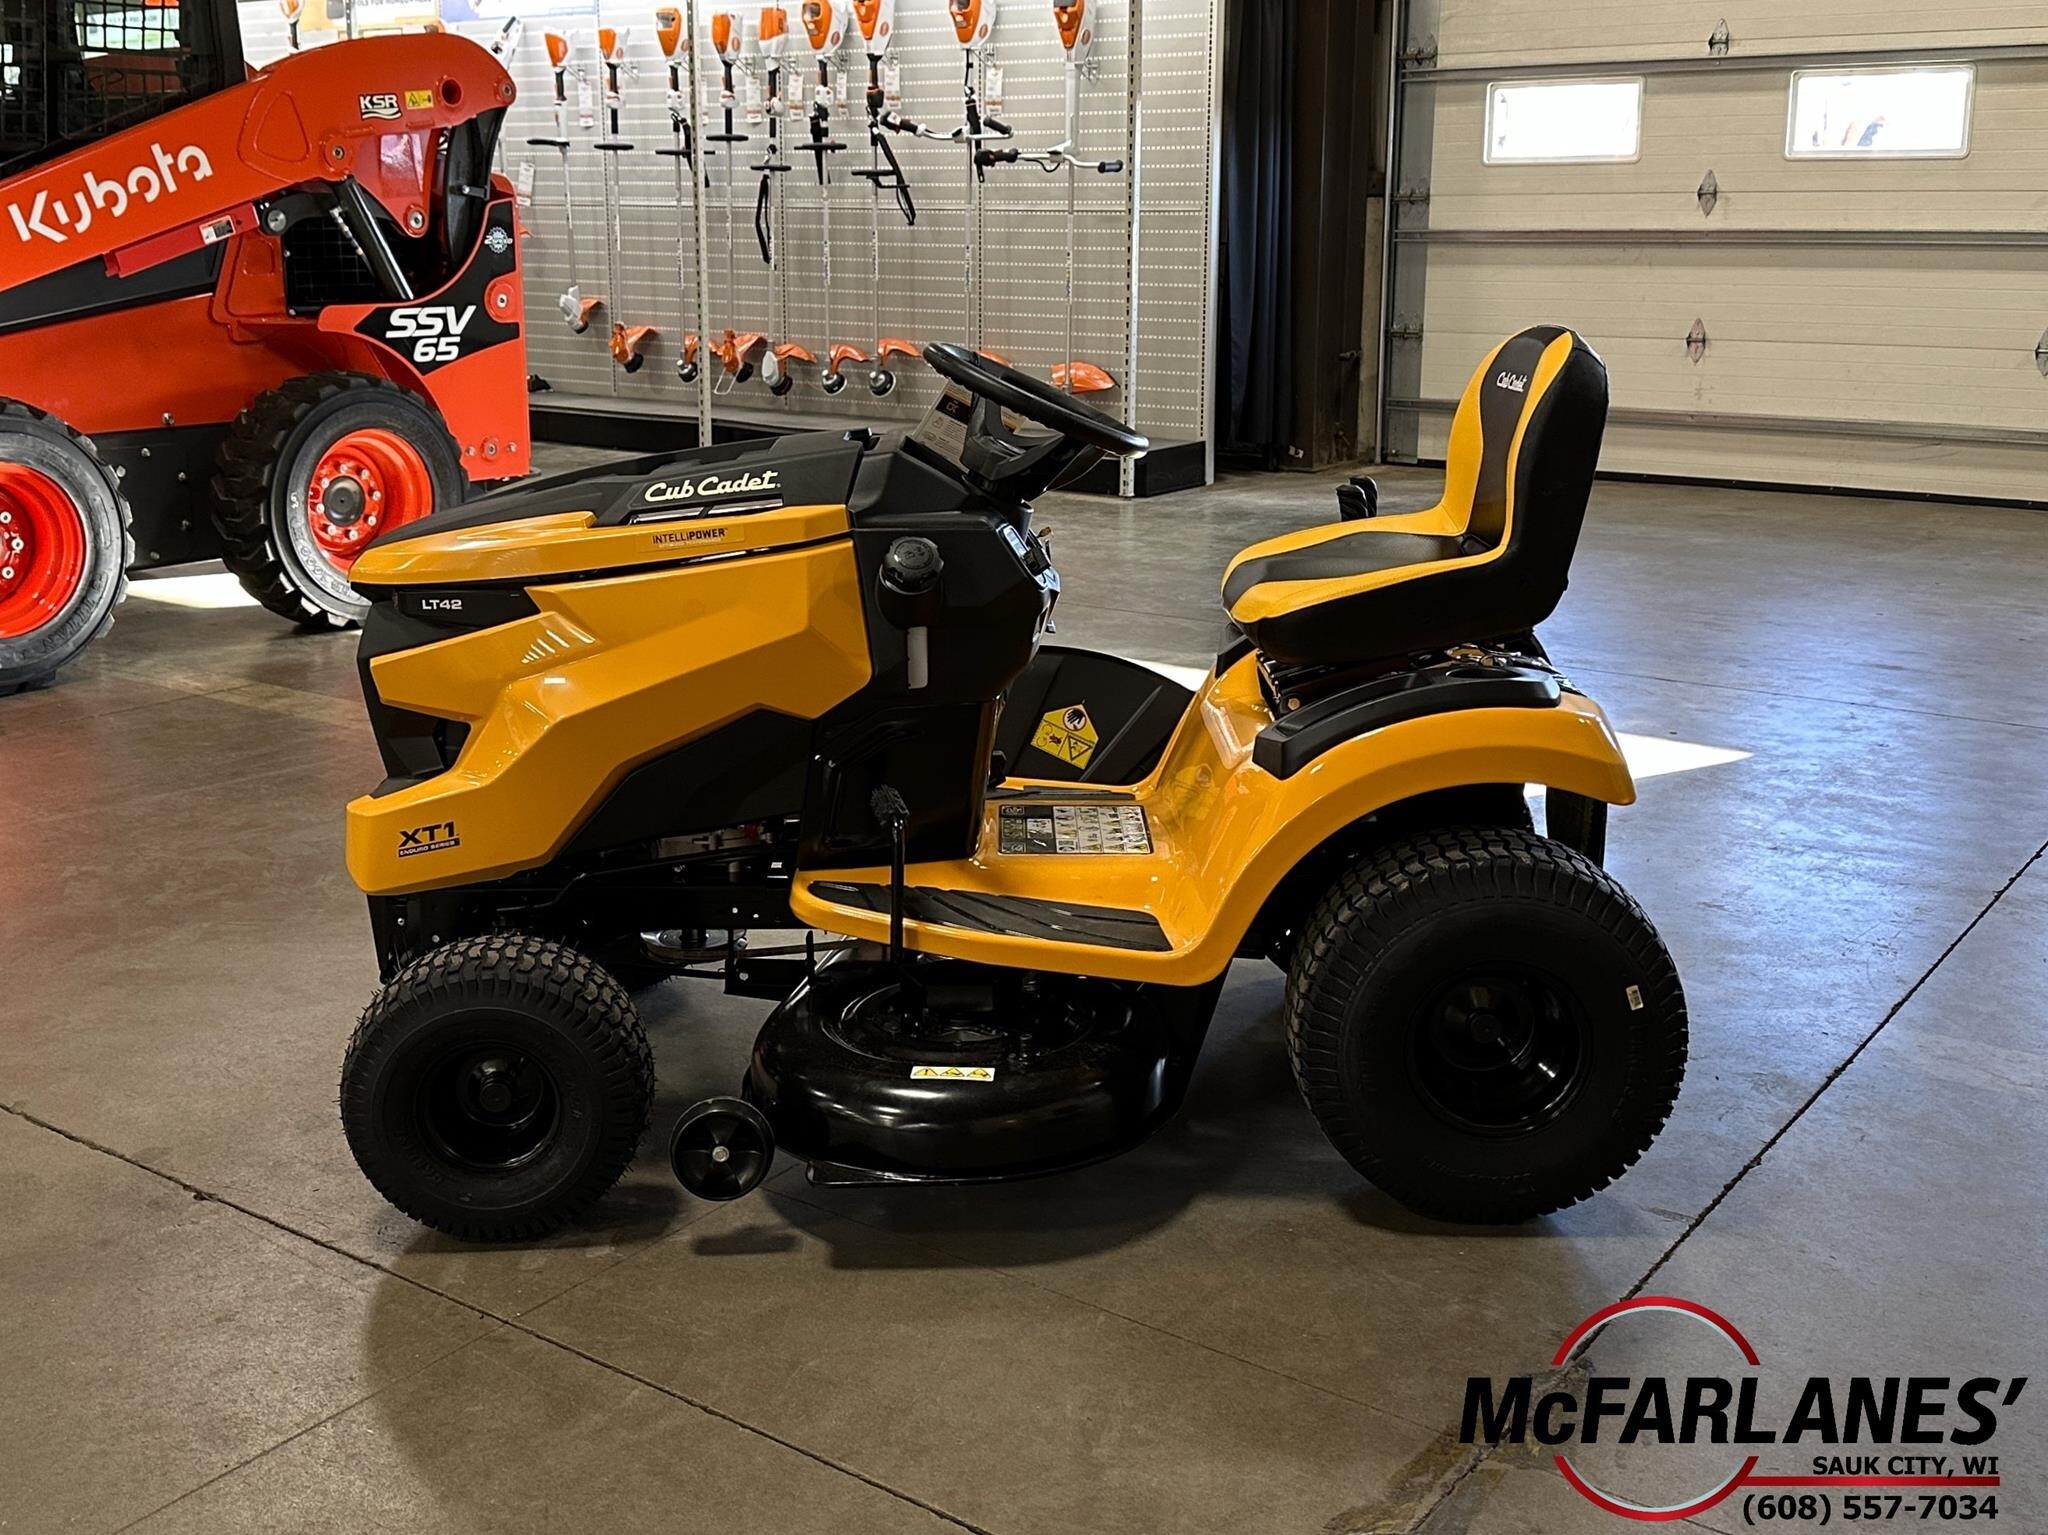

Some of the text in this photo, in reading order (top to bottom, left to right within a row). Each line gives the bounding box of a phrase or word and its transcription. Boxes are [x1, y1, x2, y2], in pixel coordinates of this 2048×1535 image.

[360, 95, 398, 109] KSR
[7, 142, 213, 243] Kubota
[385, 305, 477, 338] SSV
[413, 336, 461, 362] 65
[644, 470, 779, 502] Cub Cadet
[421, 599, 463, 610] LT42
[398, 821, 455, 848] XT1
